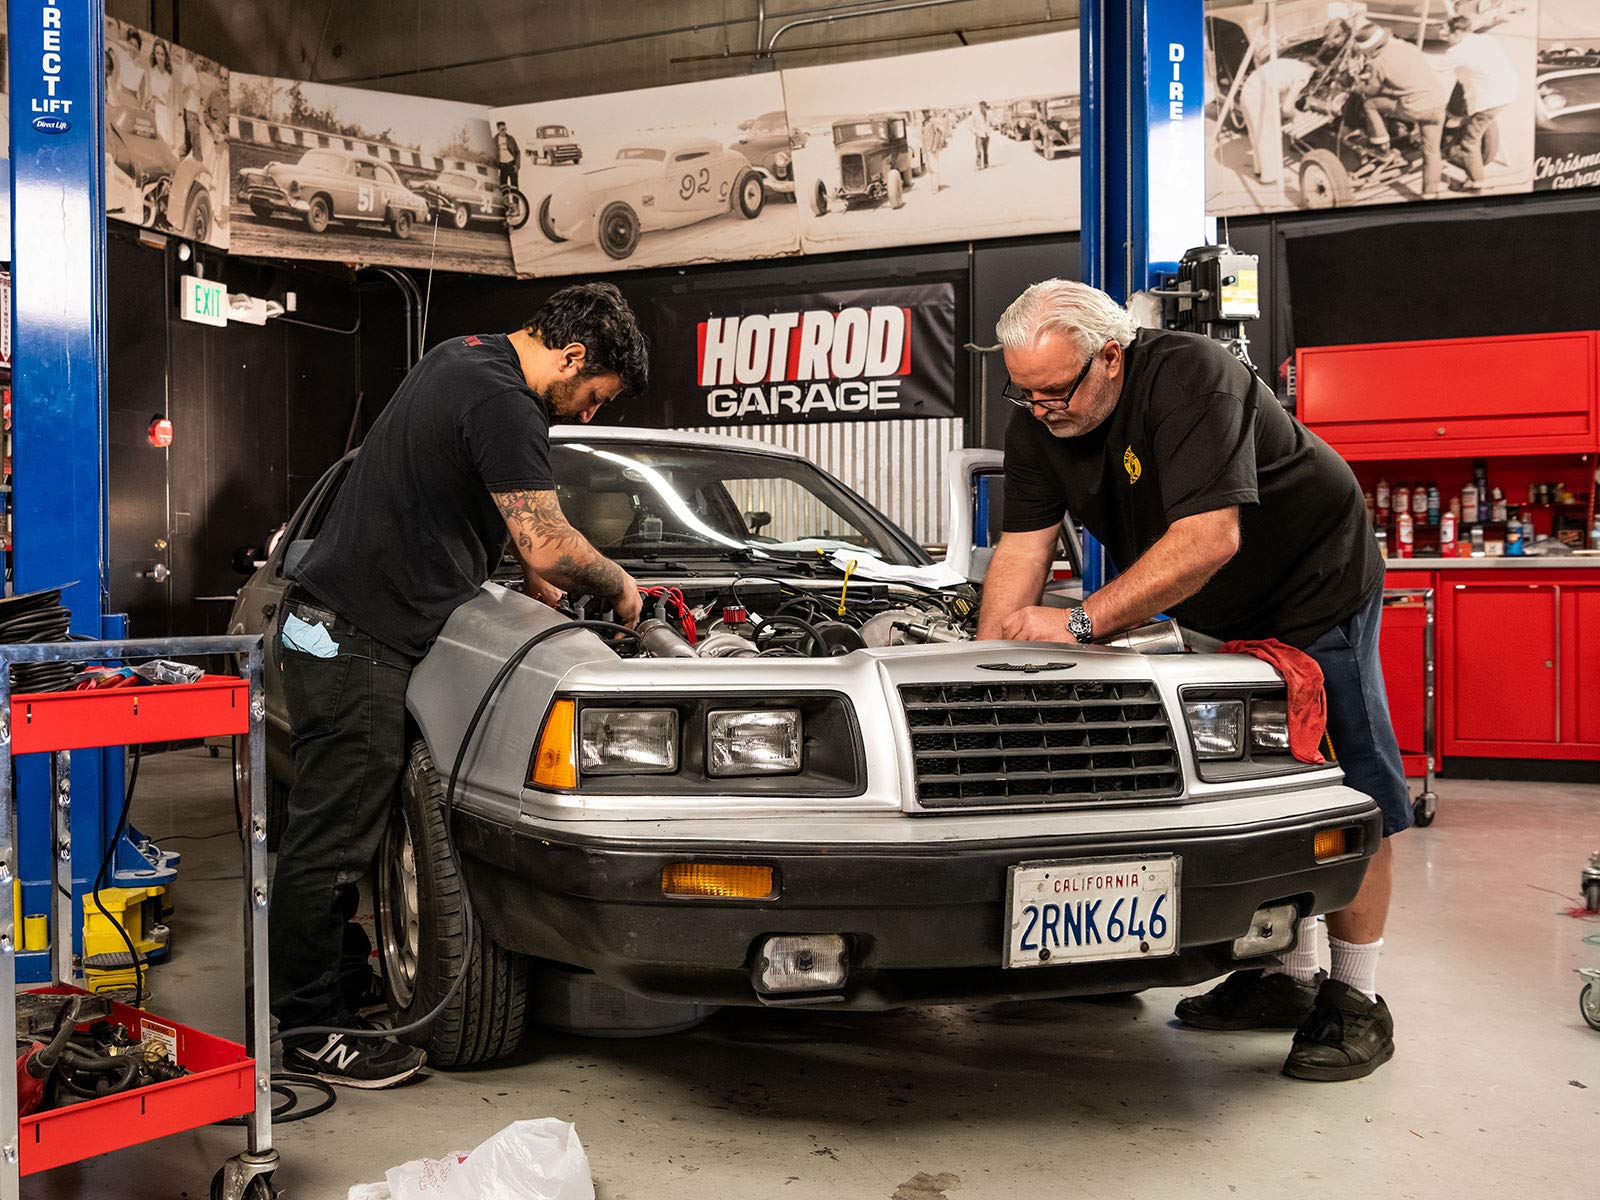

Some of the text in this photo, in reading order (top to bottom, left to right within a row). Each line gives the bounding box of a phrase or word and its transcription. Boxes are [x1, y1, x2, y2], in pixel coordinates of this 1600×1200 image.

[42, 0, 61, 97] RECT
[31, 98, 73, 114] LIFT
[36, 120, 67, 130] Direct Lift
[357, 186, 375, 213] 51
[679, 167, 711, 201] 92
[195, 284, 222, 318] EXIT
[701, 305, 905, 387] HOT ROD
[706, 380, 902, 418] GARAGE
[1053, 874, 1139, 893] CALIFORNIA
[1019, 893, 1168, 951] 2RNK646
